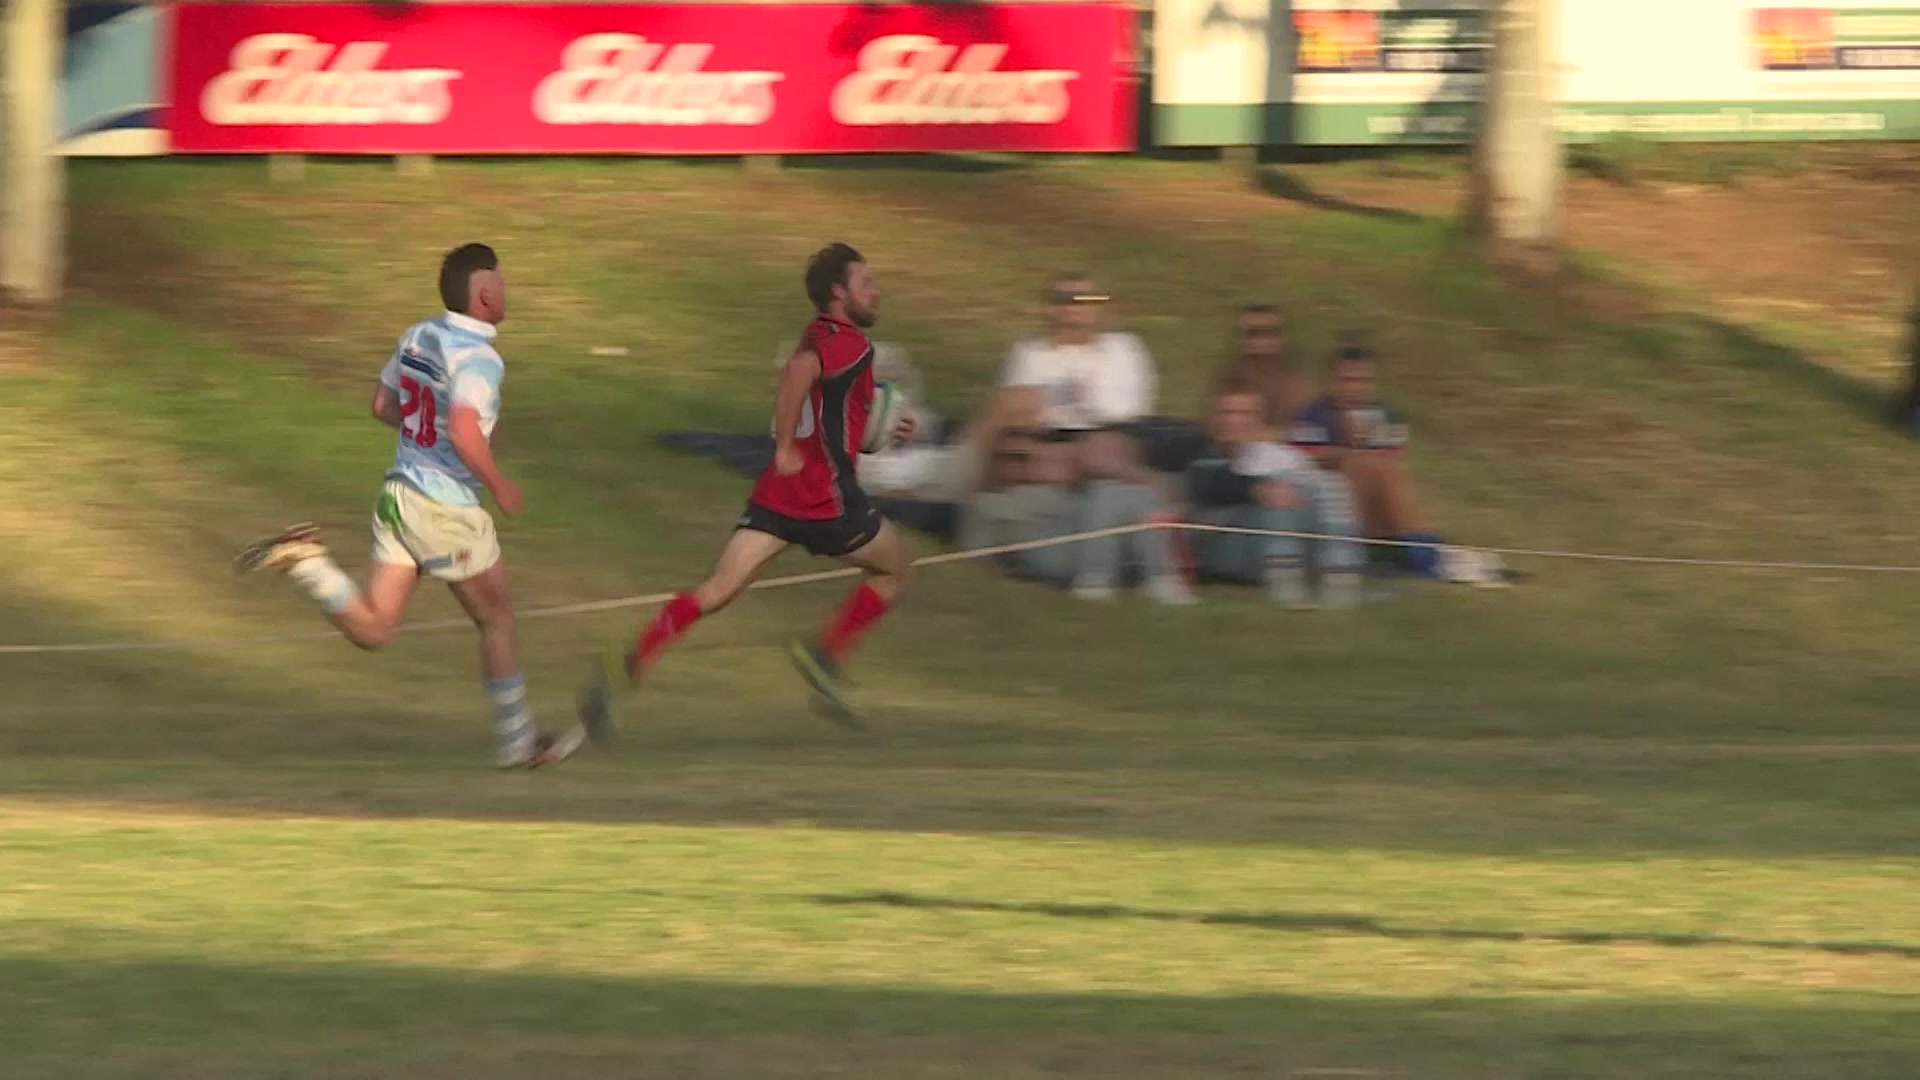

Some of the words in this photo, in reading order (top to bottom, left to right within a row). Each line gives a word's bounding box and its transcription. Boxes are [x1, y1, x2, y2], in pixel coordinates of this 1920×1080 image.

[201, 33, 463, 124] Elders
[533, 33, 784, 124] Elders
[831, 35, 1079, 125] Elders
[399, 374, 438, 448] 20
